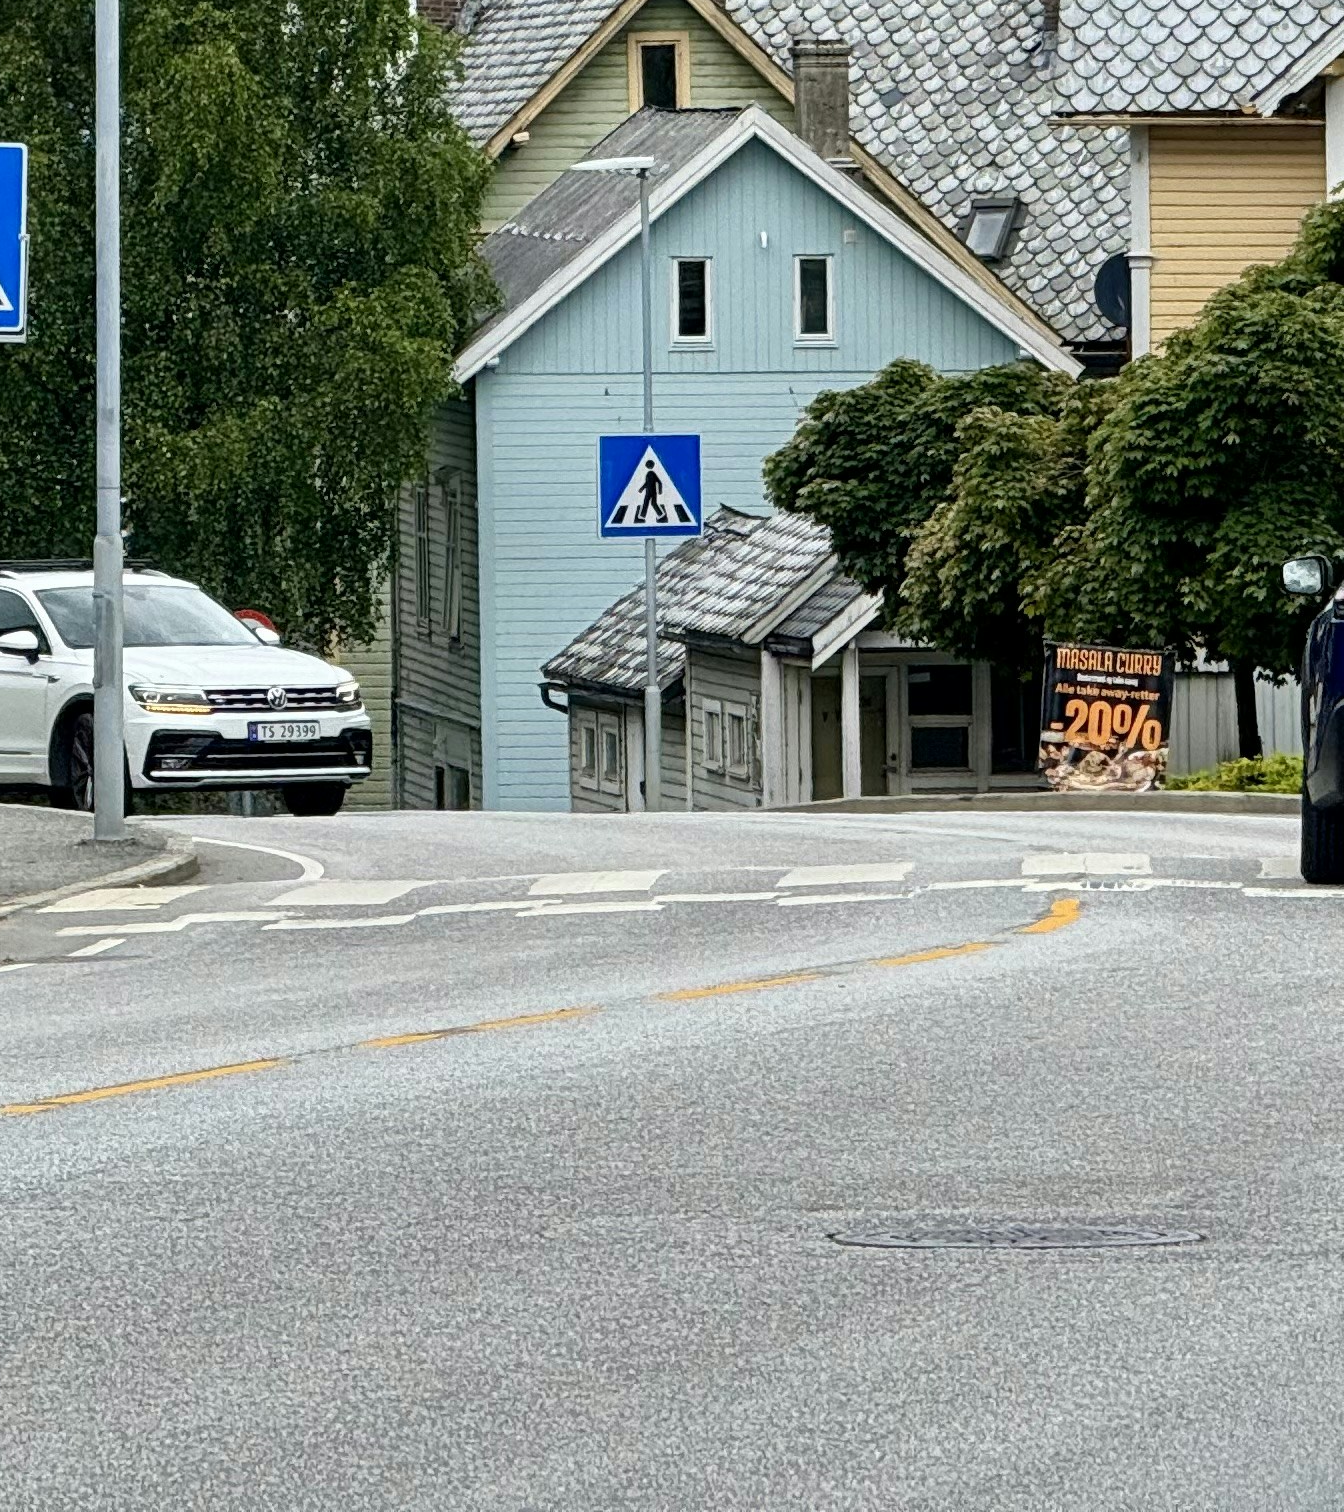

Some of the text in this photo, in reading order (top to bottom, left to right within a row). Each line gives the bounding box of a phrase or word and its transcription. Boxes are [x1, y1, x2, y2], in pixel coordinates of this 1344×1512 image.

[1056, 647, 1163, 677] MASALA CURRY
[261, 724, 317, 738] TS 29399
[1050, 698, 1163, 751] -20%
